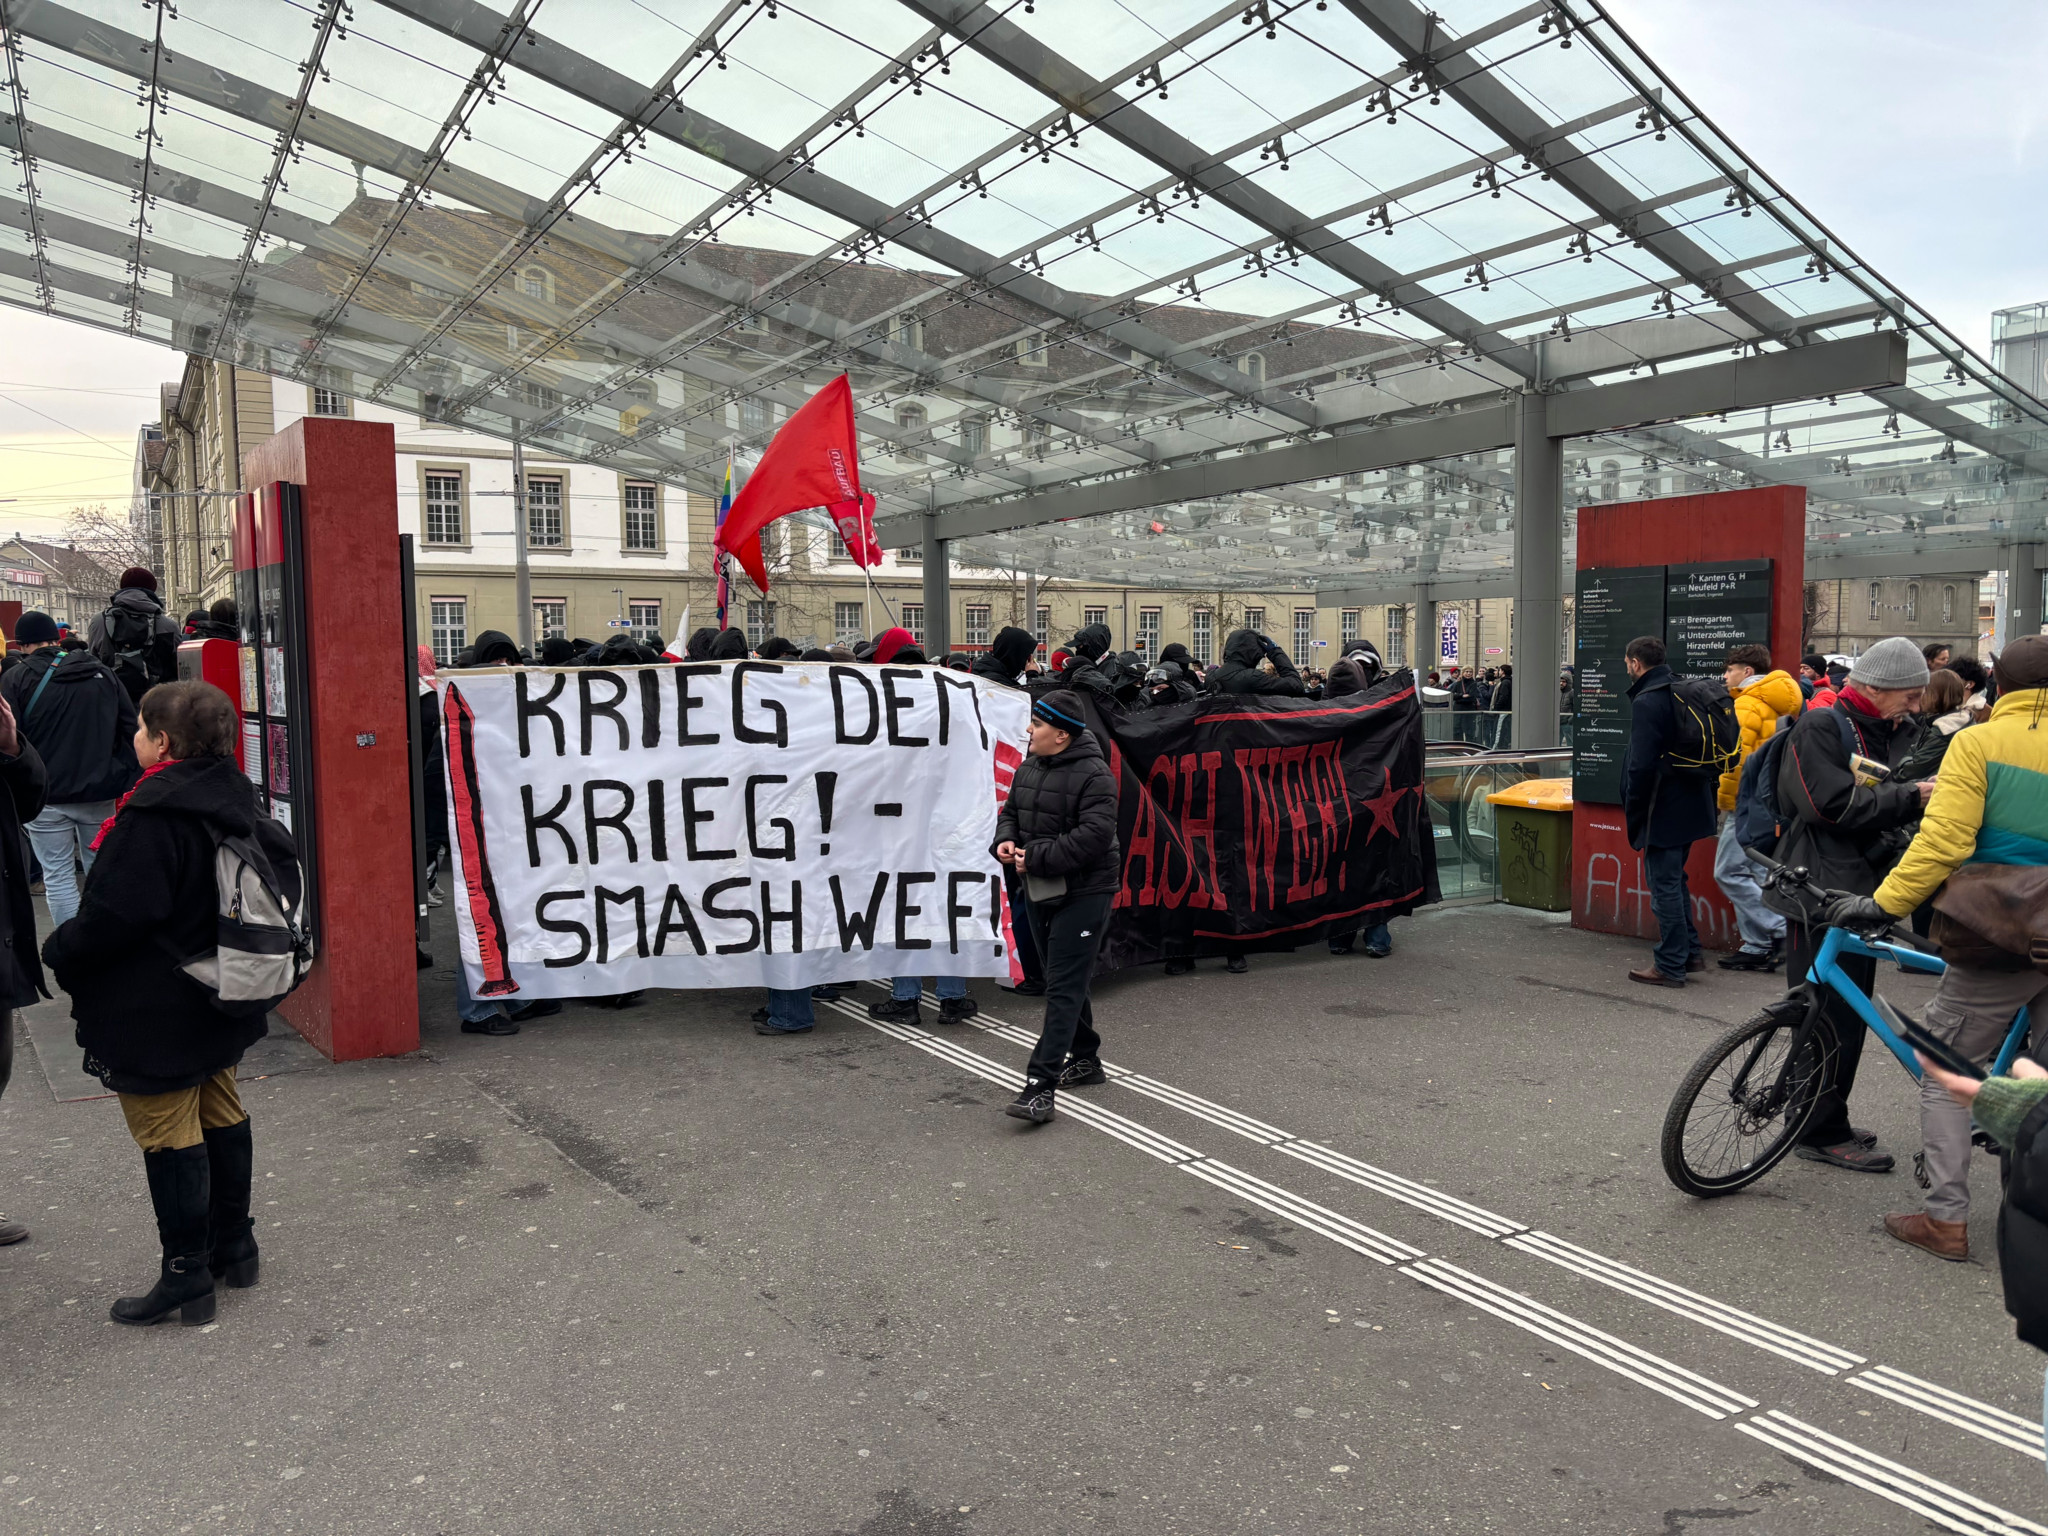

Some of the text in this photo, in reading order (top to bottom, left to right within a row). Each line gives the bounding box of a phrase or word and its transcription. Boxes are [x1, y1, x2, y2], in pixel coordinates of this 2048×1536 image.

[831, 450, 855, 498] AUFBAU
[1698, 572, 1746, 583] Kanten G, H
[1688, 583, 1718, 592] Neufeld
[1720, 582, 1736, 590] P+R
[1687, 615, 1732, 625] Bremgarten
[1687, 630, 1745, 639] Unterzollikofen
[1686, 641, 1726, 650] Hirzenfeld
[1696, 660, 1724, 668] Kanten
[515, 661, 989, 759] KRIEG DEM
[520, 770, 838, 868] KRIEG!
[1110, 739, 1228, 911] ASH
[1589, 823, 1622, 832] www.jesus.ch
[535, 871, 1004, 969] SMASH WEF!
